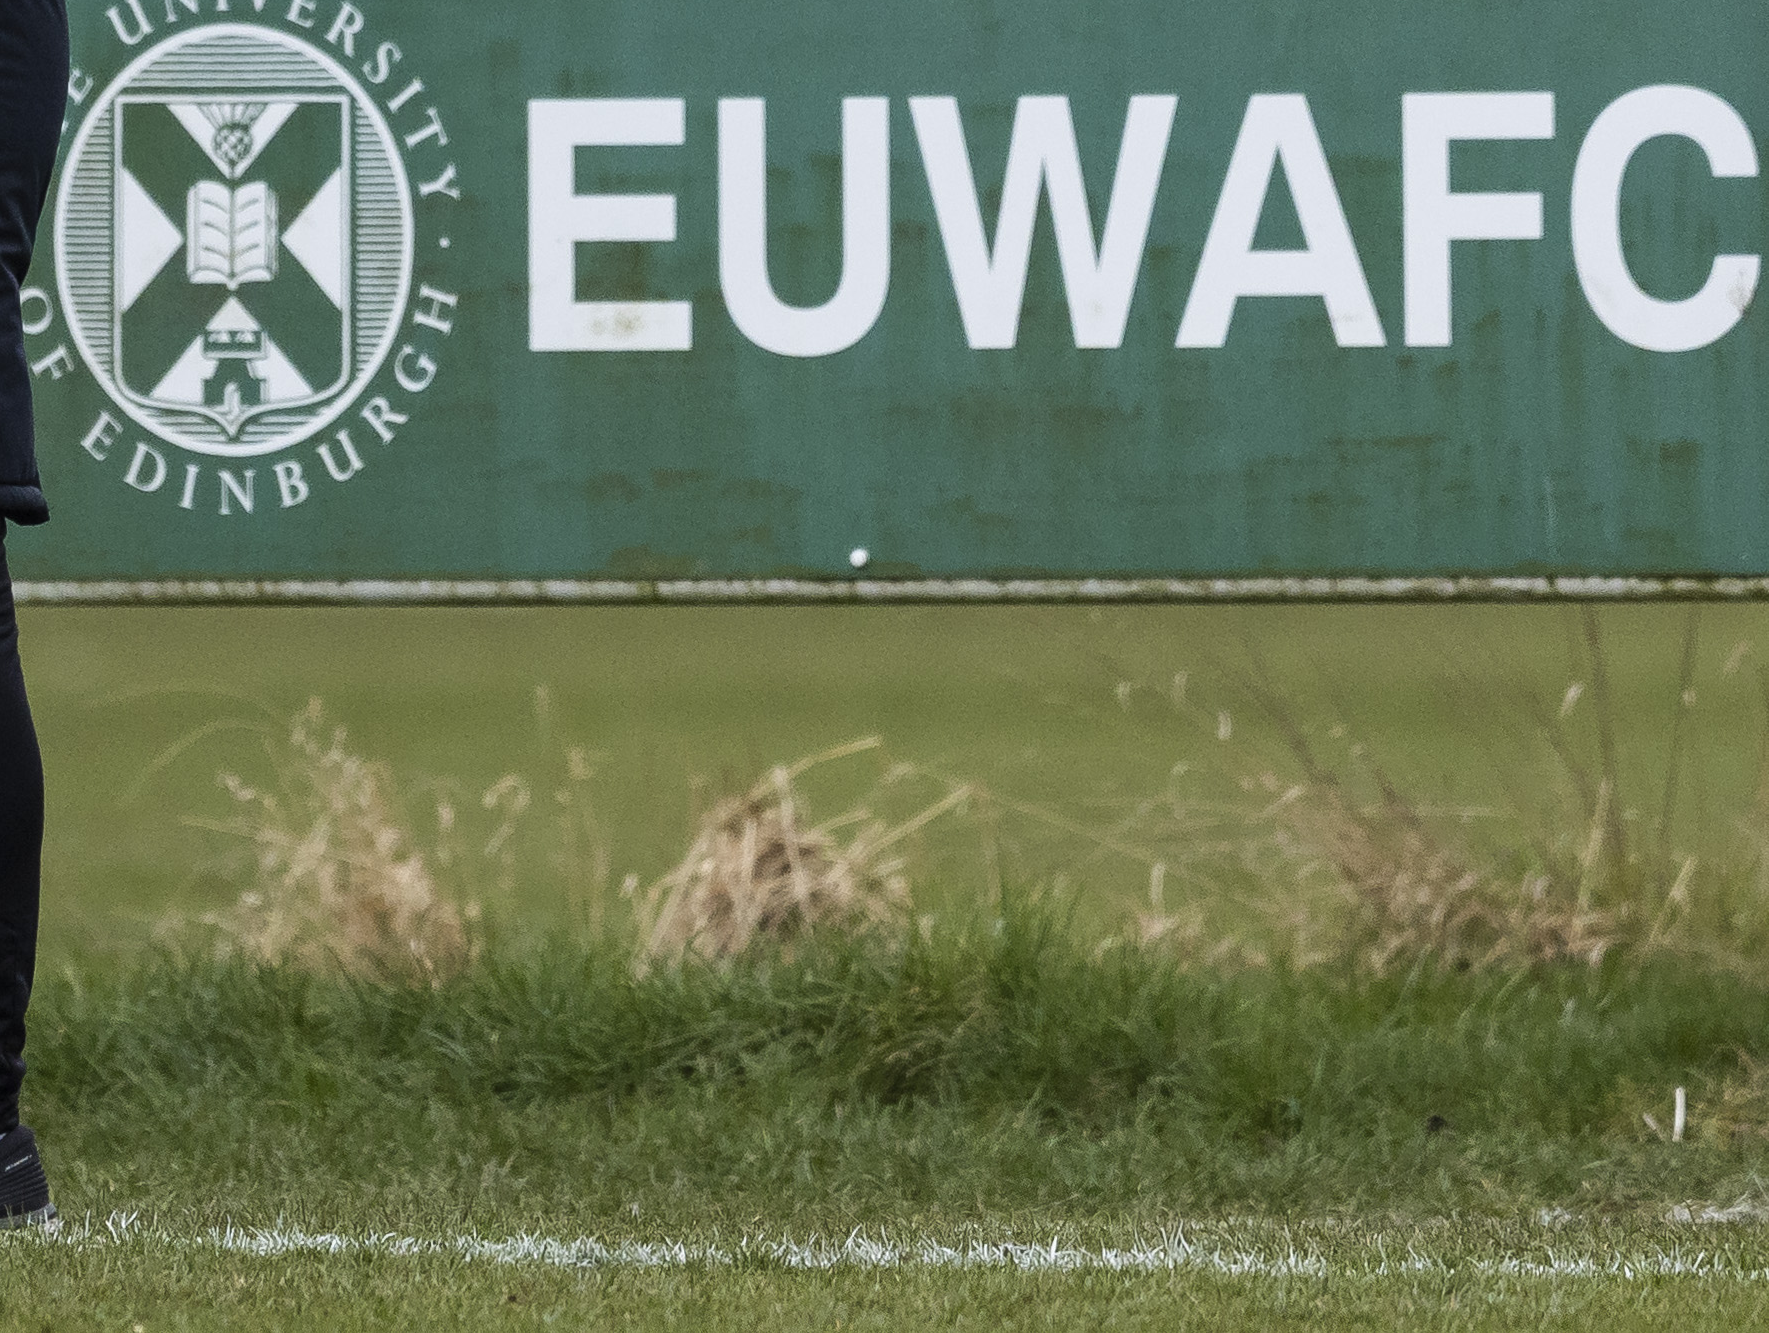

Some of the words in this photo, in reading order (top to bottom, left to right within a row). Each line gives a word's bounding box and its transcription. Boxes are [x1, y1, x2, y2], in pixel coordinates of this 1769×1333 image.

[526, 83, 1763, 358] EUWAFC
[19, 285, 75, 380] OF
[80, 282, 460, 516] EDINBURGH
